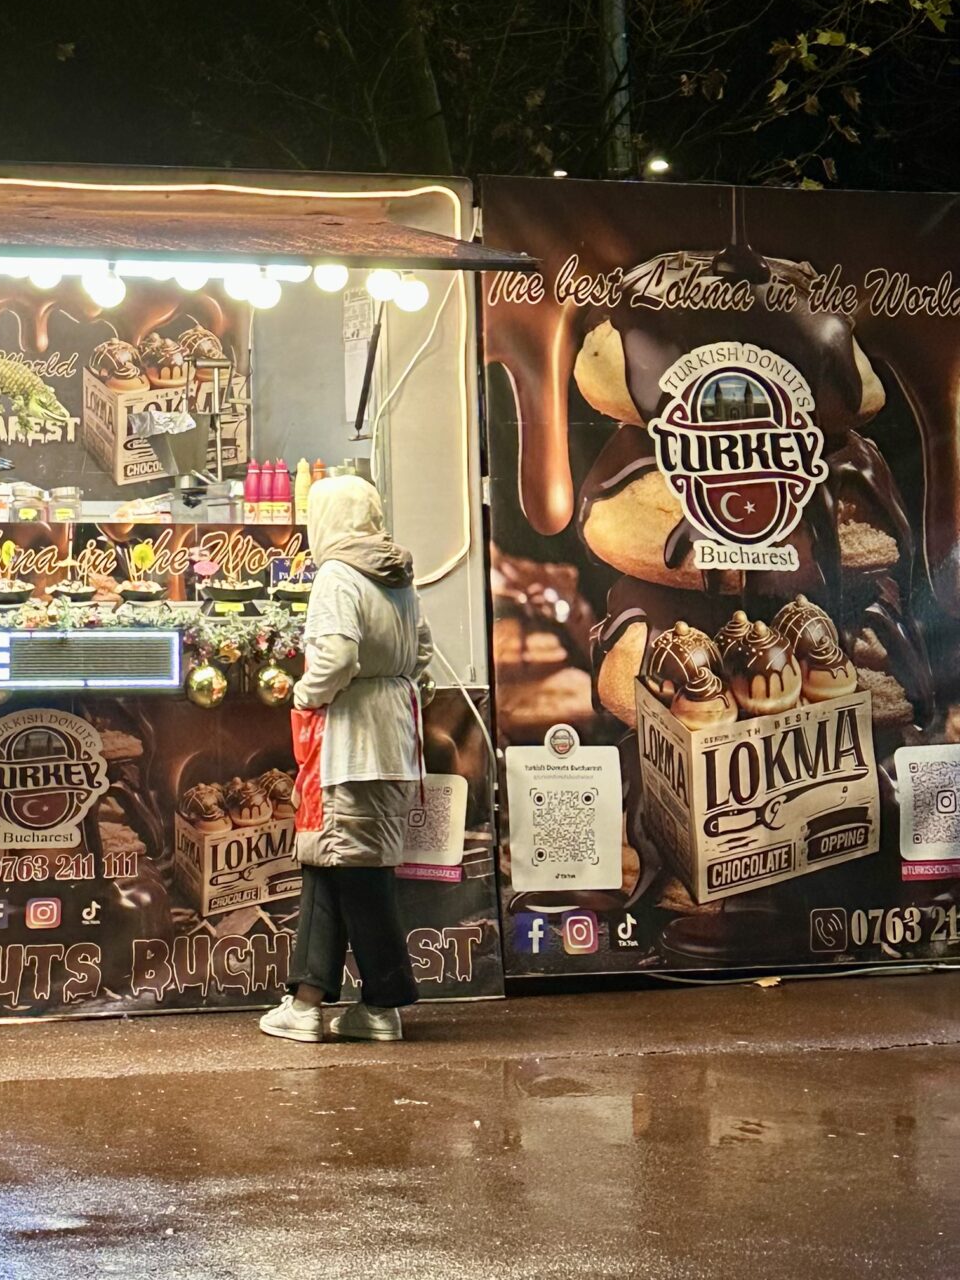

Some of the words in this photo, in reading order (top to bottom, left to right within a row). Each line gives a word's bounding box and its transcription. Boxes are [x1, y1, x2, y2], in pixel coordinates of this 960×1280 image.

[554, 254, 624, 308] best
[630, 256, 755, 310] Lokma
[764, 274, 797, 312] in
[808, 264, 858, 315] the
[664, 347, 740, 391] TURKISH
[746, 349, 811, 408] DONUTS
[652, 423, 824, 478] TURKEY
[699, 546, 795, 565] Bucharest
[48, 714, 96, 749] DONUTS
[774, 711, 812, 731] BEST
[641, 713, 690, 808] LOKMA
[702, 708, 869, 812] LOKMA
[3, 831, 74, 844] Bucharest
[210, 828, 296, 874] LOKM
[711, 848, 790, 887] CHOCOLATE
[820, 827, 866, 854] OPPING
[55, 853, 95, 880] 211
[102, 851, 139, 879] 111
[851, 906, 922, 946] 0763
[132, 925, 483, 1003] BUCHST
